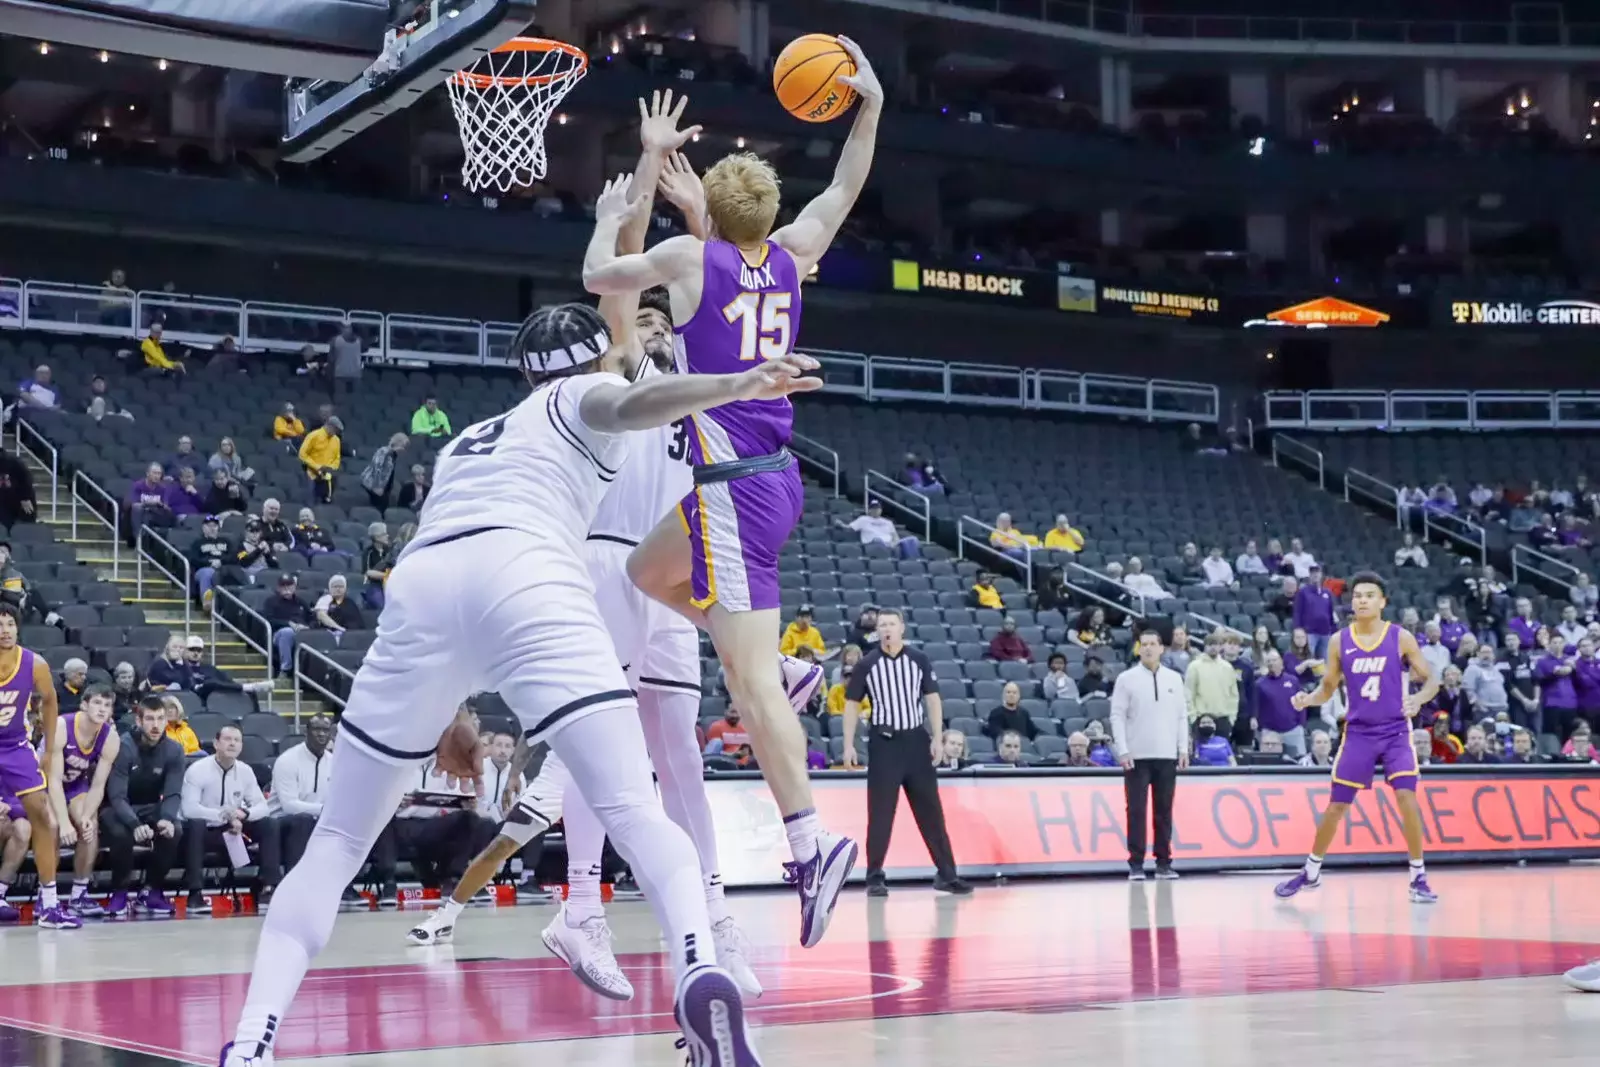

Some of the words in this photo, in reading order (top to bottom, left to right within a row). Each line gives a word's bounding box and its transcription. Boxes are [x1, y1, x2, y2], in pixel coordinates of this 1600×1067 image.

[806, 91, 838, 118] NCAA
[922, 269, 961, 290] H&R
[965, 274, 1024, 297] BLOCK
[1102, 287, 1160, 306] BOULEVARD
[1161, 293, 1205, 310] BREWING
[722, 292, 792, 361] 15
[1295, 311, 1359, 321] SERVPRO
[1536, 307, 1600, 324] CENTER
[667, 418, 693, 467] 3
[1351, 656, 1387, 673] UNI
[1361, 675, 1381, 702] 4
[1029, 788, 1203, 856] HAL
[1212, 787, 1290, 850] OF
[585, 961, 617, 989] TRUST
